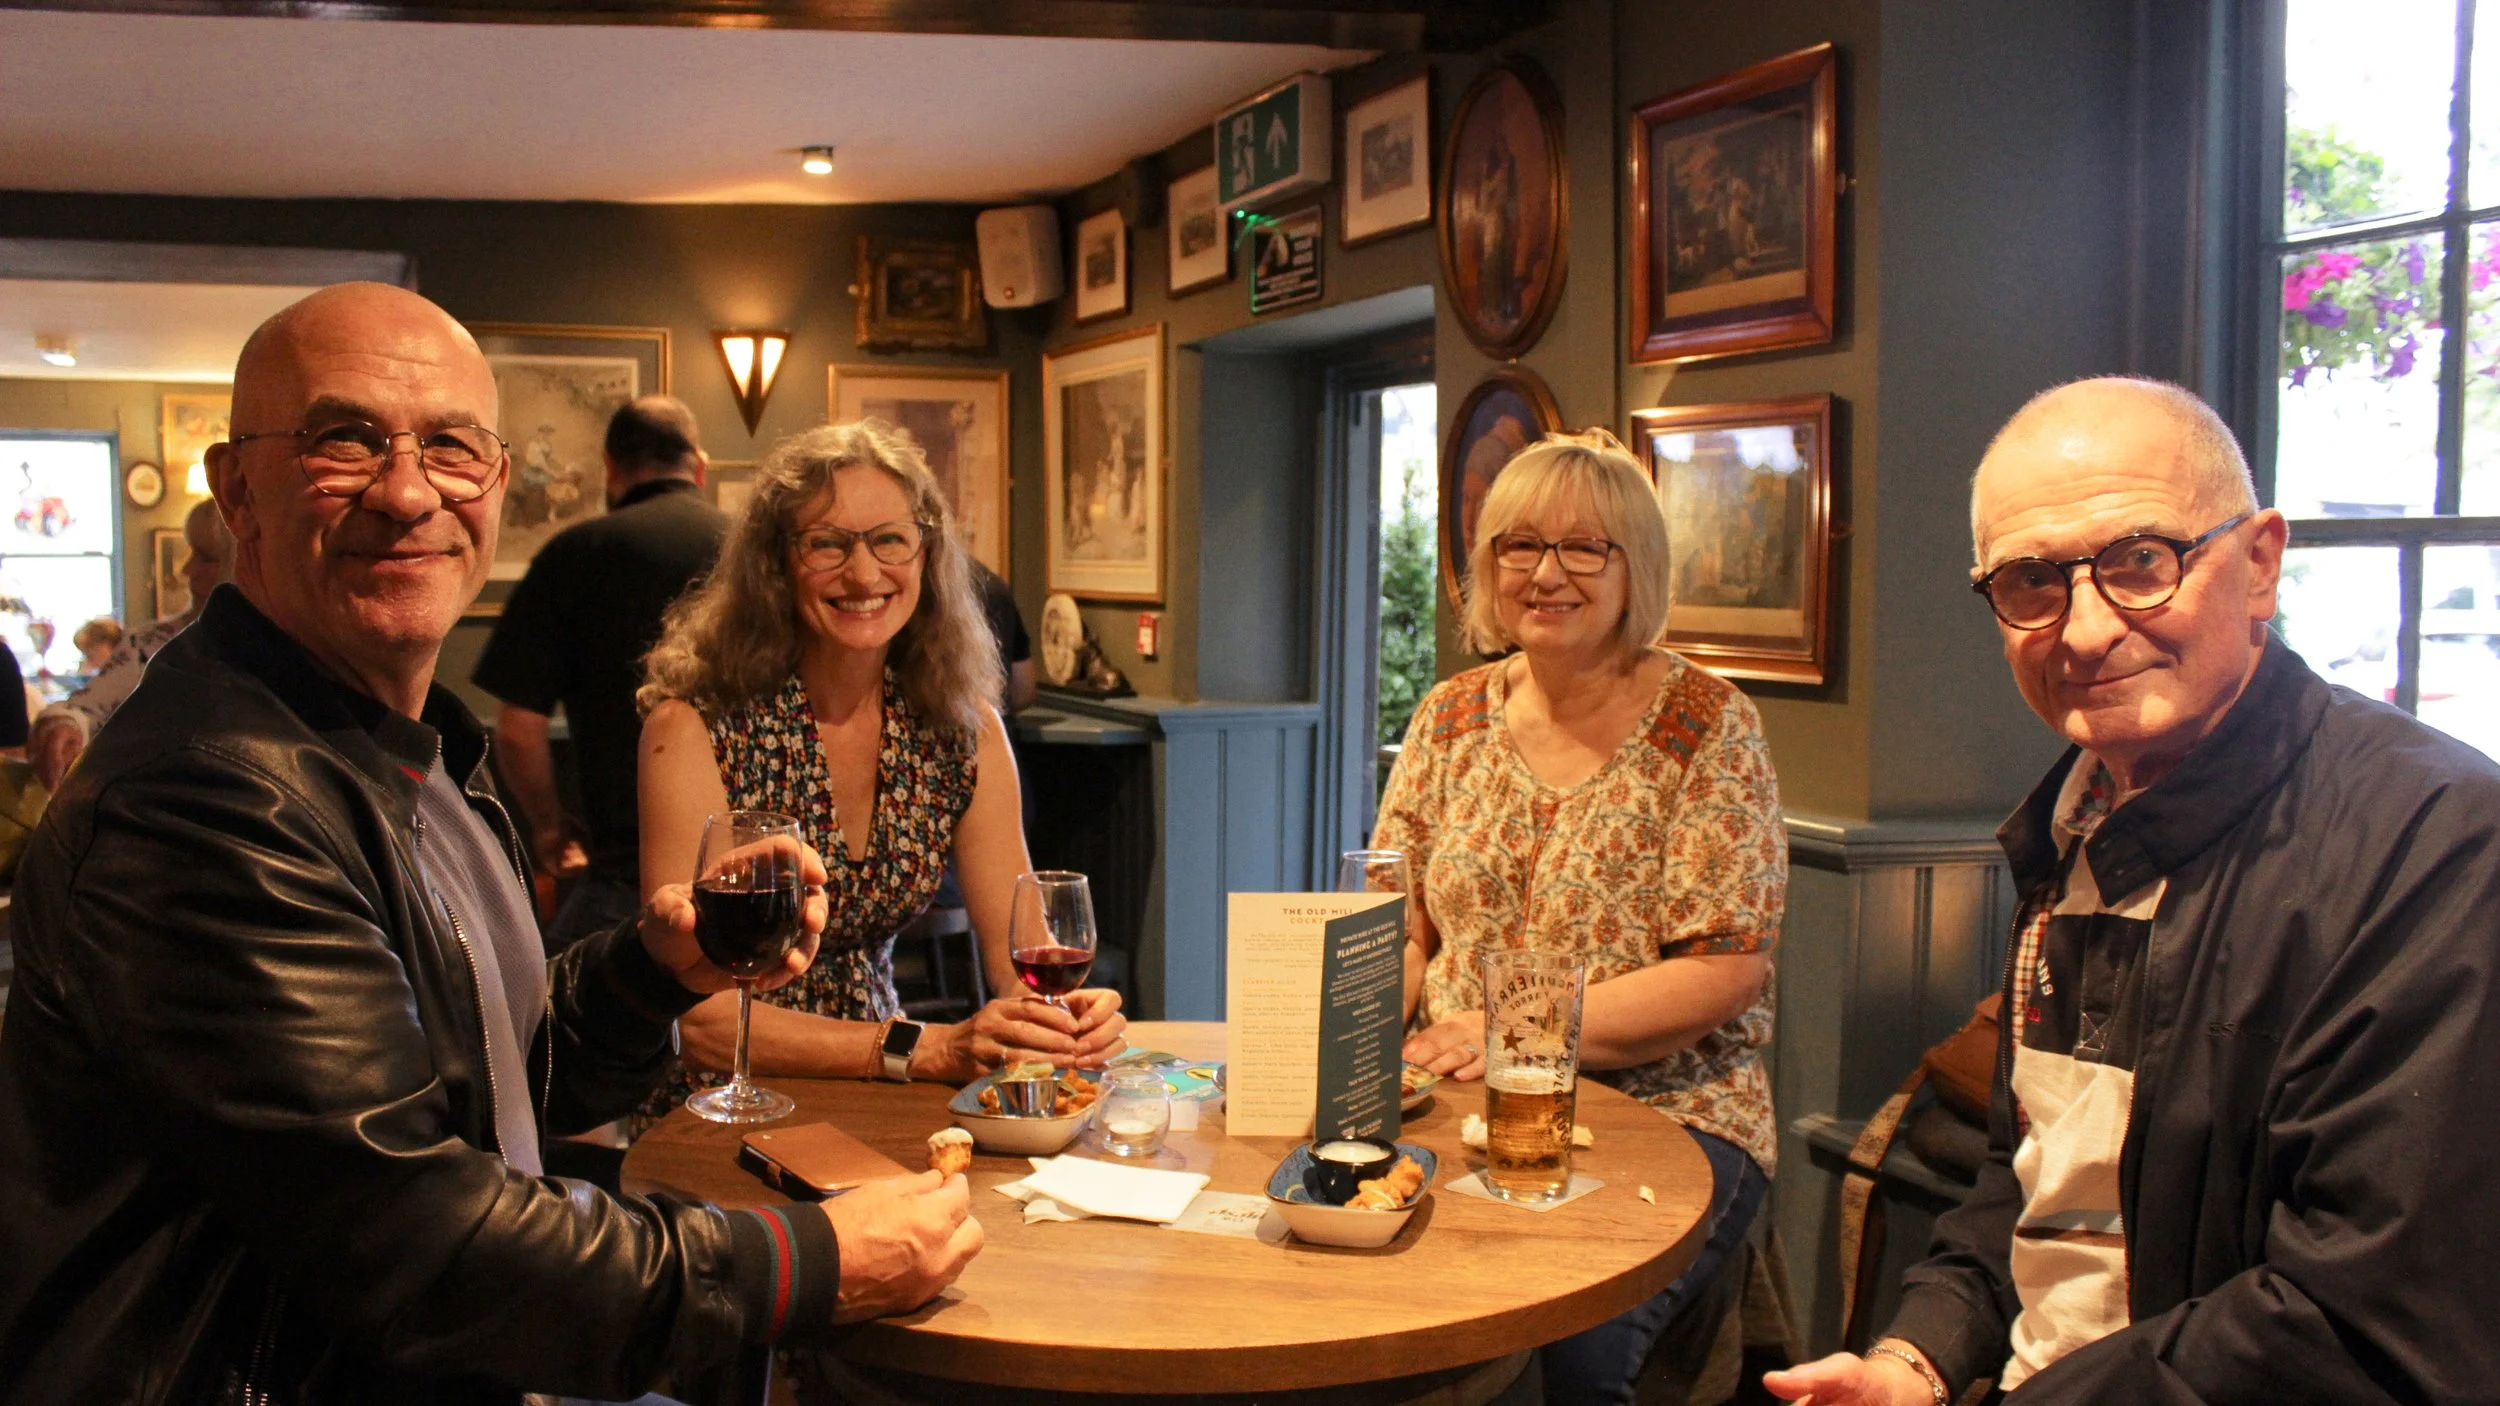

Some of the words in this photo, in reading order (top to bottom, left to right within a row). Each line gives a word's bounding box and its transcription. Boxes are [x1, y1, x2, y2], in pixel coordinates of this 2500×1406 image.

[1289, 916, 1325, 925] COCKT
[1336, 940, 1371, 959] PLANNING
[1372, 939, 1377, 947] A
